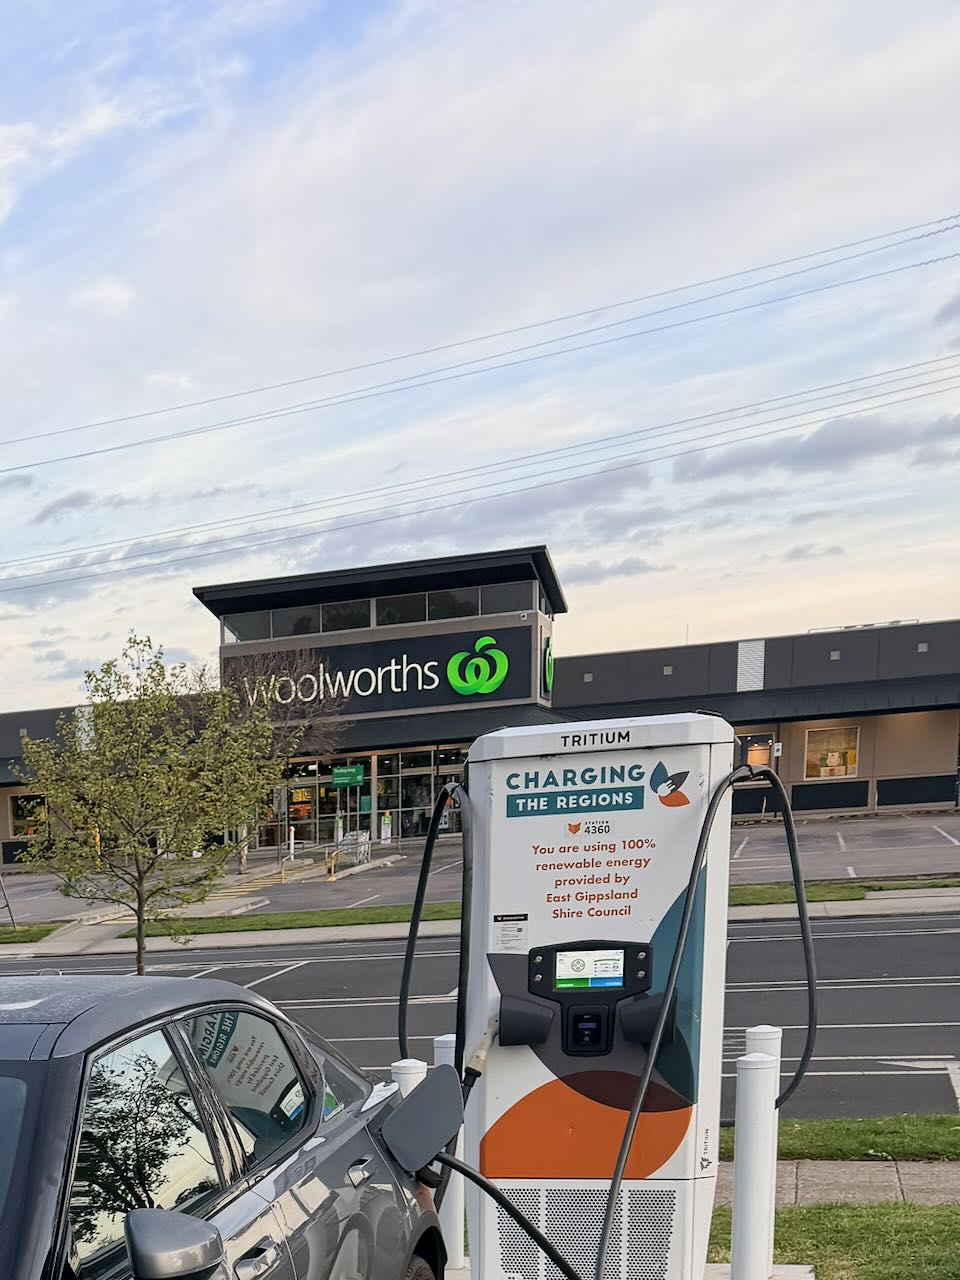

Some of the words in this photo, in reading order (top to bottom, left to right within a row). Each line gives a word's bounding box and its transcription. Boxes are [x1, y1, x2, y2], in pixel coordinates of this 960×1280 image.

[243, 654, 440, 706] woolworths
[560, 730, 631, 747] TRITIUM
[506, 763, 646, 790] CHARGING
[516, 797, 548, 812] THE
[556, 791, 633, 809] REGIONS
[584, 825, 611, 835] 4360
[532, 845, 555, 855] You
[558, 845, 580, 853] are
[583, 841, 617, 853] using
[621, 838, 656, 850] 100%
[535, 857, 602, 871] renewable
[606, 857, 651, 869] energy
[554, 873, 611, 889] provided
[614, 872, 631, 886] by
[546, 892, 572, 903] East
[574, 888, 638, 904] Gippsland
[552, 908, 583, 919] Shire
[587, 905, 632, 917] Council
